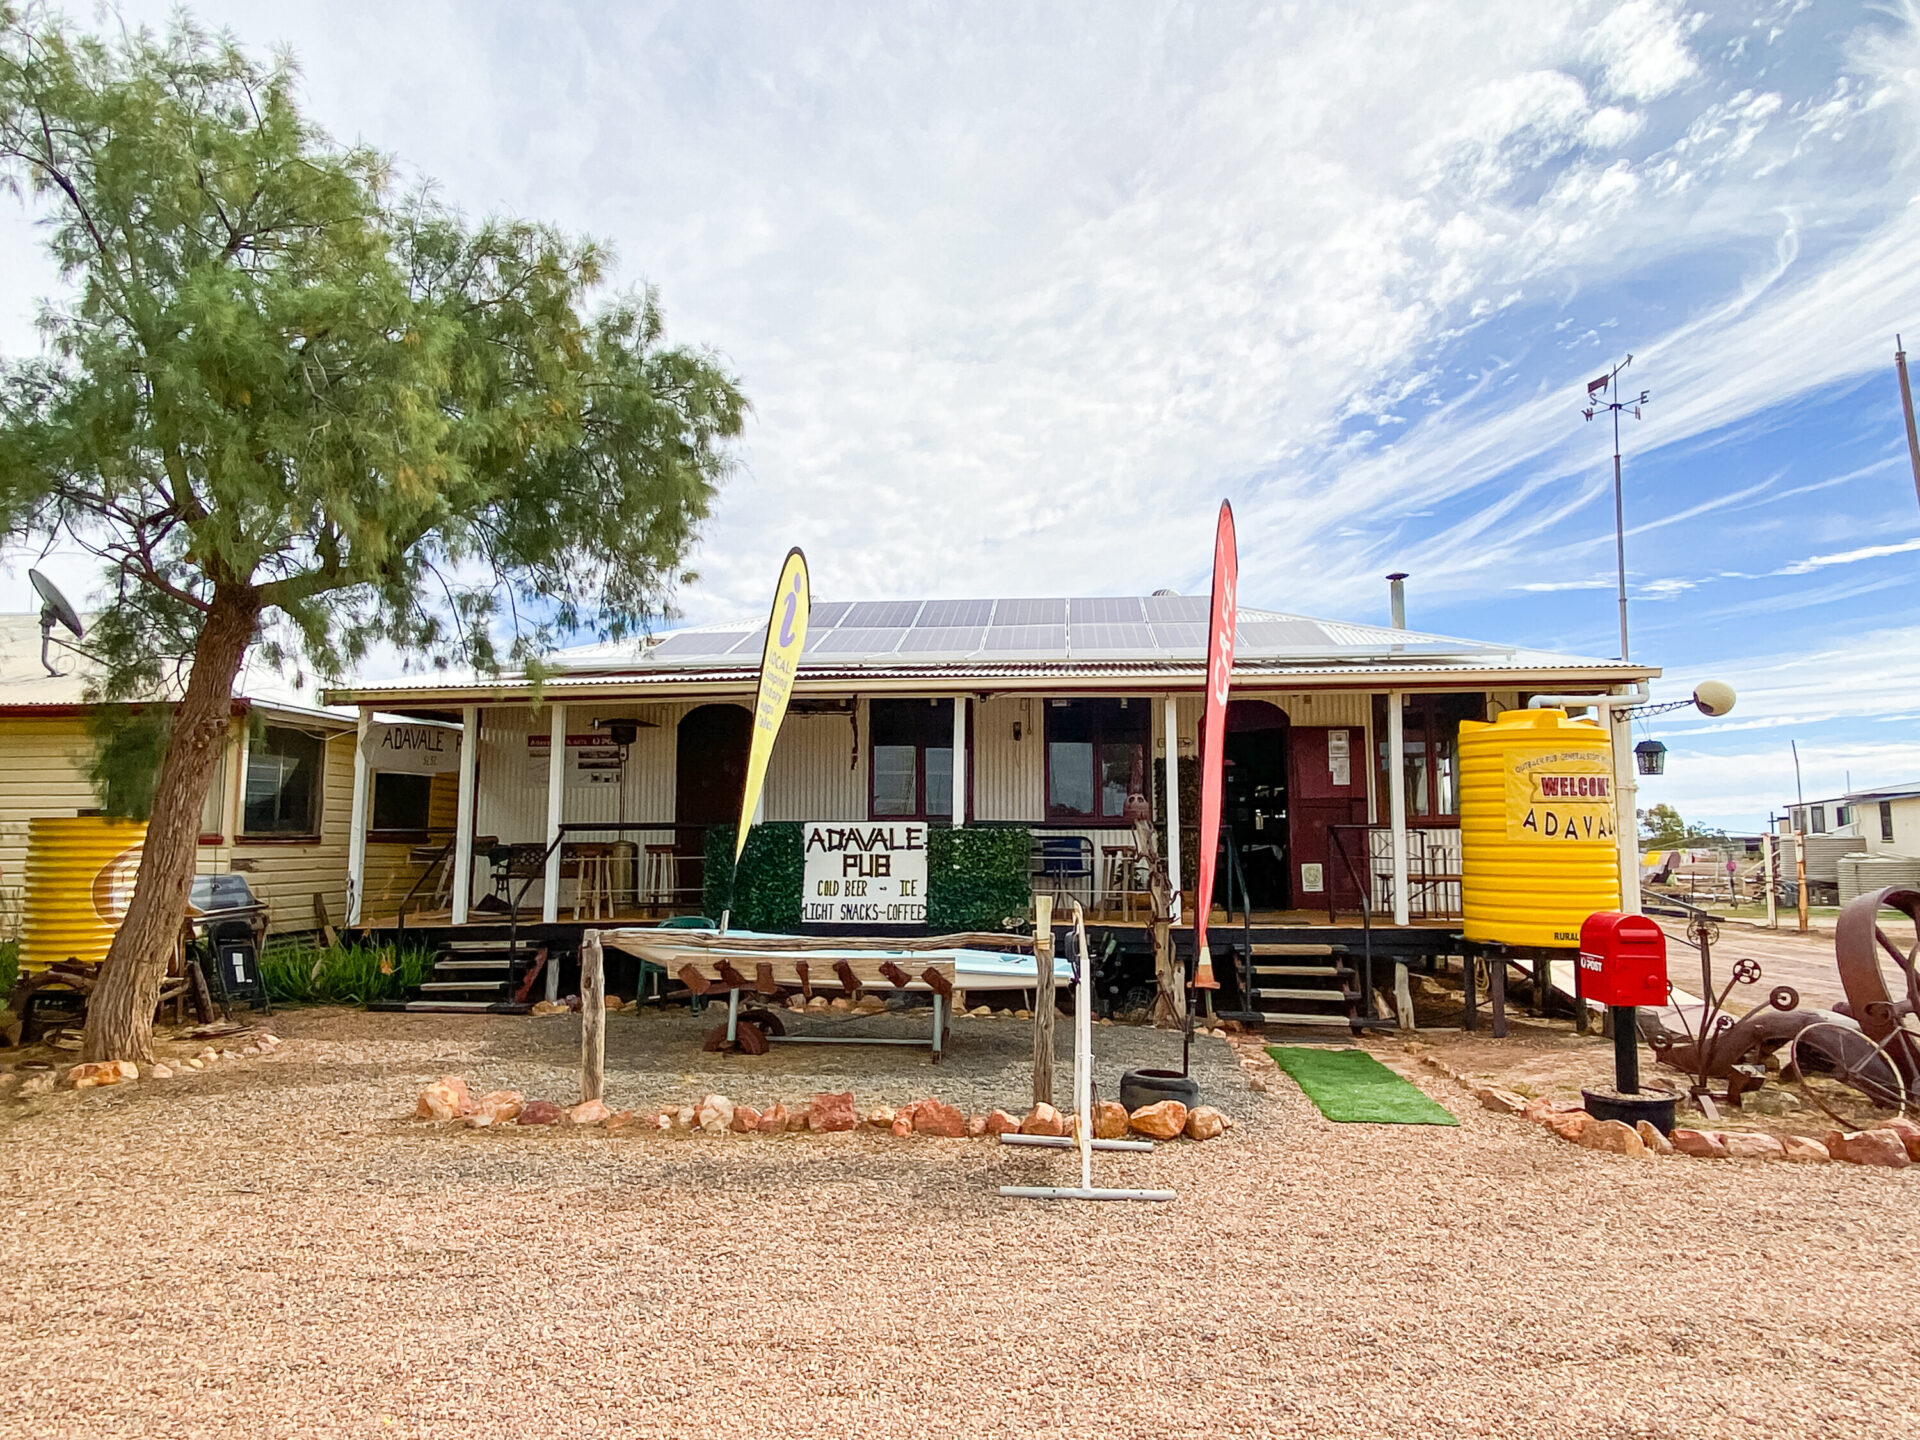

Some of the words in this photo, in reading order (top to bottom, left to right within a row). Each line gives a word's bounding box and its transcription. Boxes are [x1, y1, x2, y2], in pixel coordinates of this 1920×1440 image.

[381, 728, 444, 752] ADAVALE
[1545, 754, 1558, 763] PUB
[806, 827, 924, 853] ADAVALE
[842, 853, 891, 878] PUB
[817, 880, 840, 897] COLD
[844, 880, 868, 897] BEER
[899, 879, 918, 897] ICE
[804, 902, 835, 921] LIGHT
[1553, 932, 1580, 942] RURAL
[1586, 959, 1603, 973] POST
